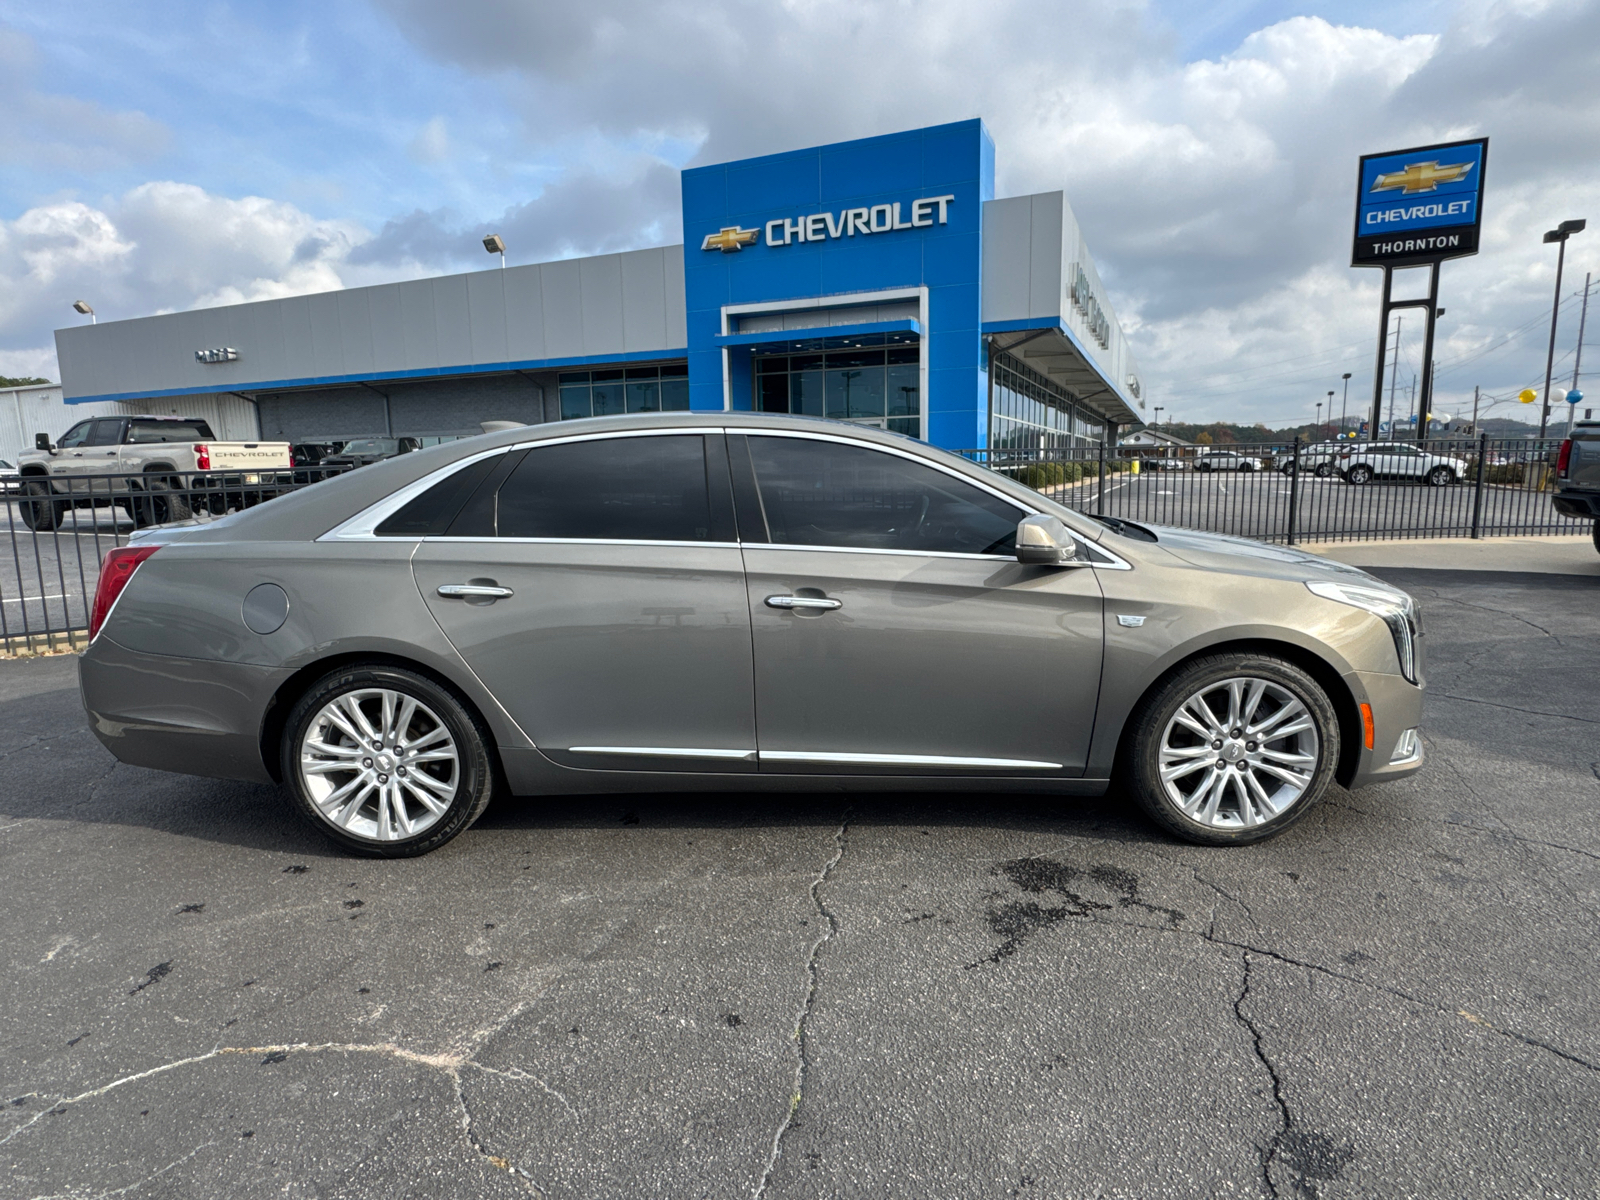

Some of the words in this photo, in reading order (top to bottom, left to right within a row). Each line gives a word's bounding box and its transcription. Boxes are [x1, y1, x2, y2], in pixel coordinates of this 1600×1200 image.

[765, 194, 955, 247] CHEVROLET
[1366, 200, 1471, 225] CHEVROLET
[1372, 234, 1460, 255] THORNTON
